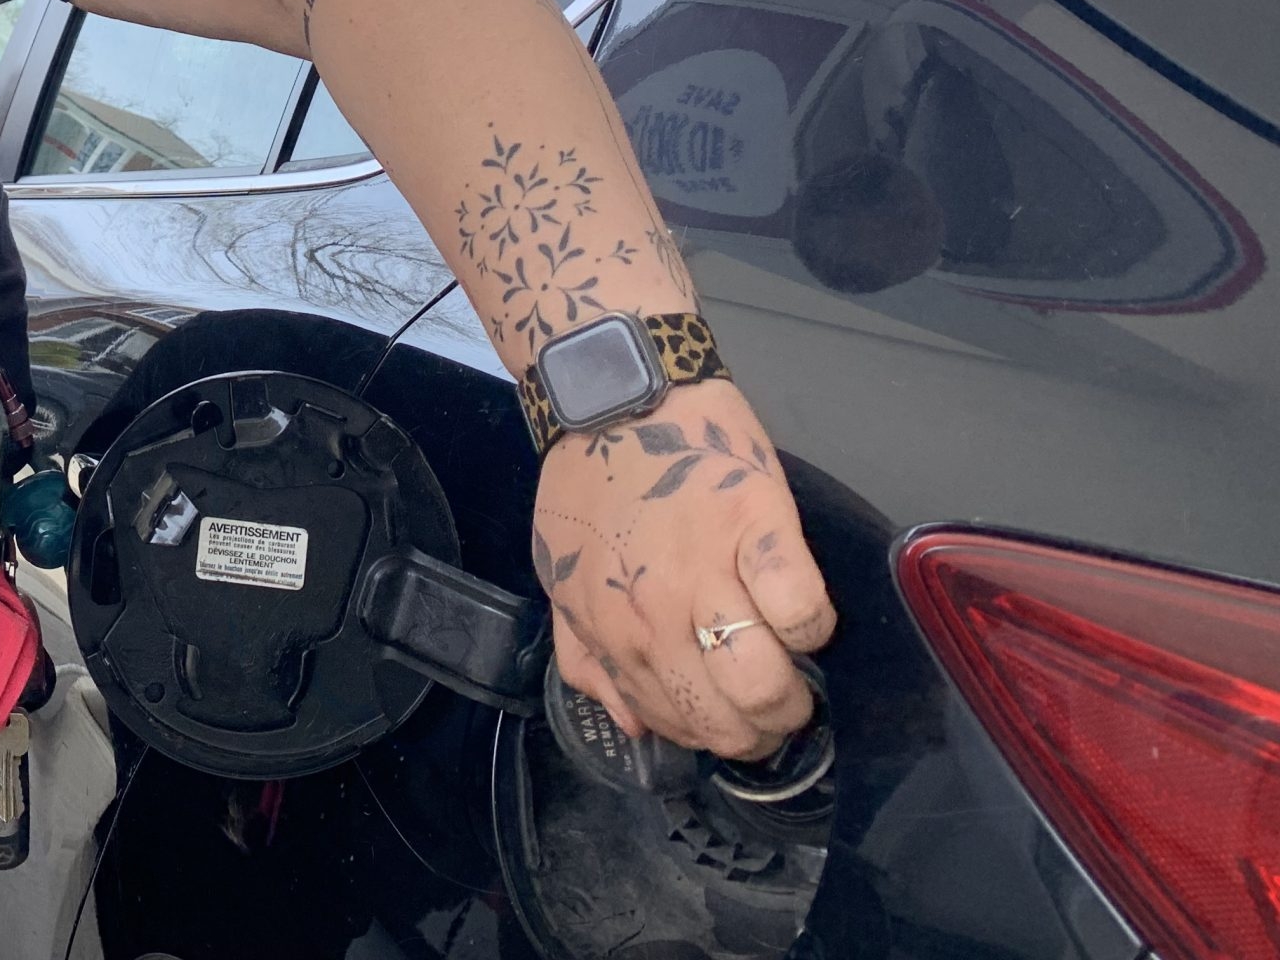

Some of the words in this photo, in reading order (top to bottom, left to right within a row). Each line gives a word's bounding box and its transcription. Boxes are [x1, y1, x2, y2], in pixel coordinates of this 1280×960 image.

[208, 522, 302, 543] AVERTISSEMENT
[229, 557, 274, 568] LENTEMENT
[246, 552, 256, 560] LE
[259, 554, 297, 565] BOUCHON
[574, 694, 598, 742] WARN
